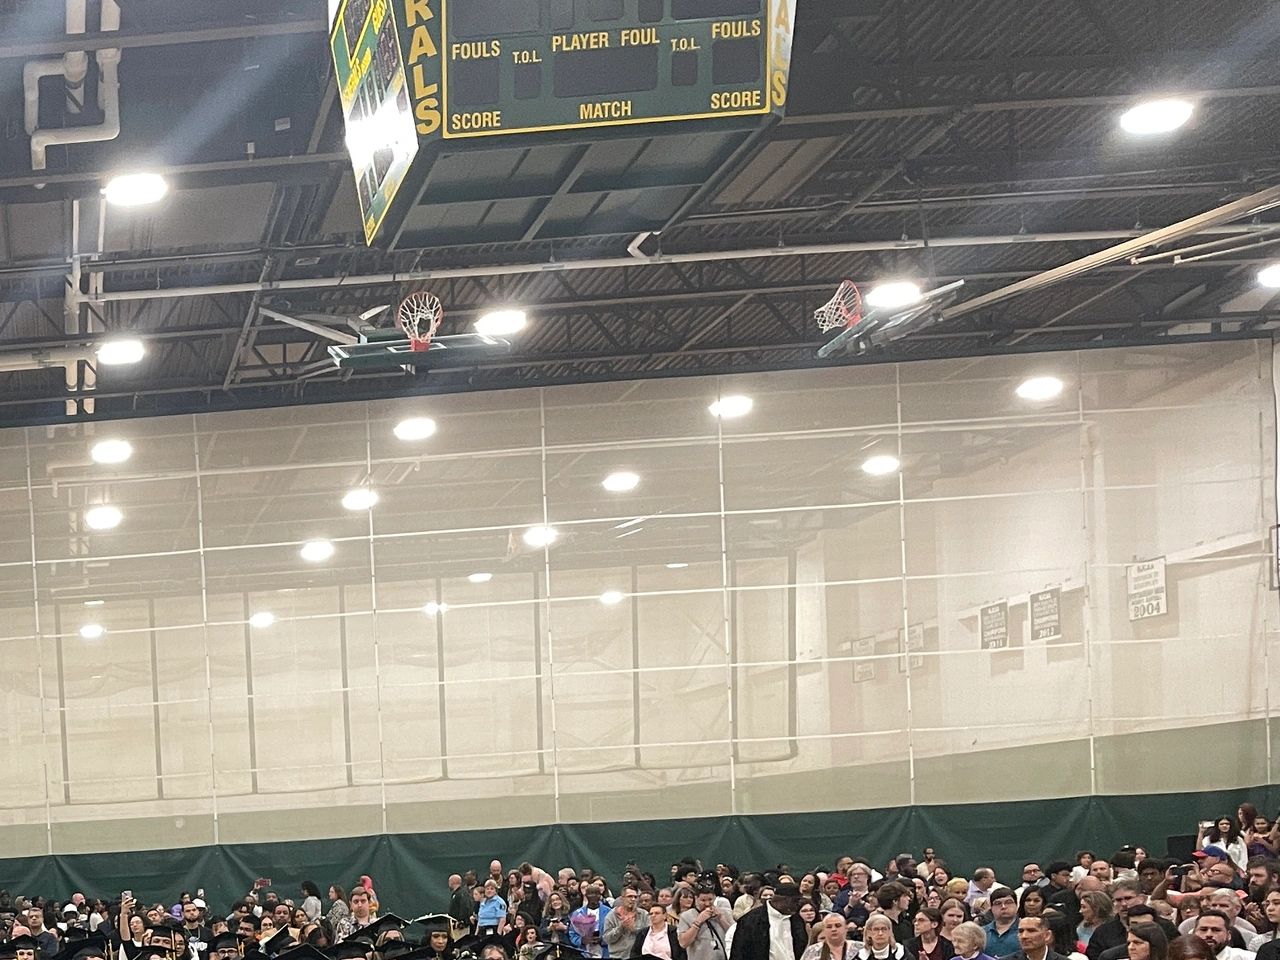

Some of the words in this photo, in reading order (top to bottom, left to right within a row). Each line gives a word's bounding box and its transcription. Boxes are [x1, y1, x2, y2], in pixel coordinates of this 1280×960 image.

[712, 19, 761, 39] FOULS
[552, 31, 609, 52] PLAYER
[621, 28, 661, 47] FOUL
[671, 38, 701, 52] T.O.L.
[452, 40, 501, 60] FOULS
[512, 50, 542, 64] T.O.L.
[710, 90, 761, 109] SCORE
[579, 100, 632, 120] MATCH
[451, 111, 501, 130] SCORE
[1133, 601, 1161, 618] 2004
